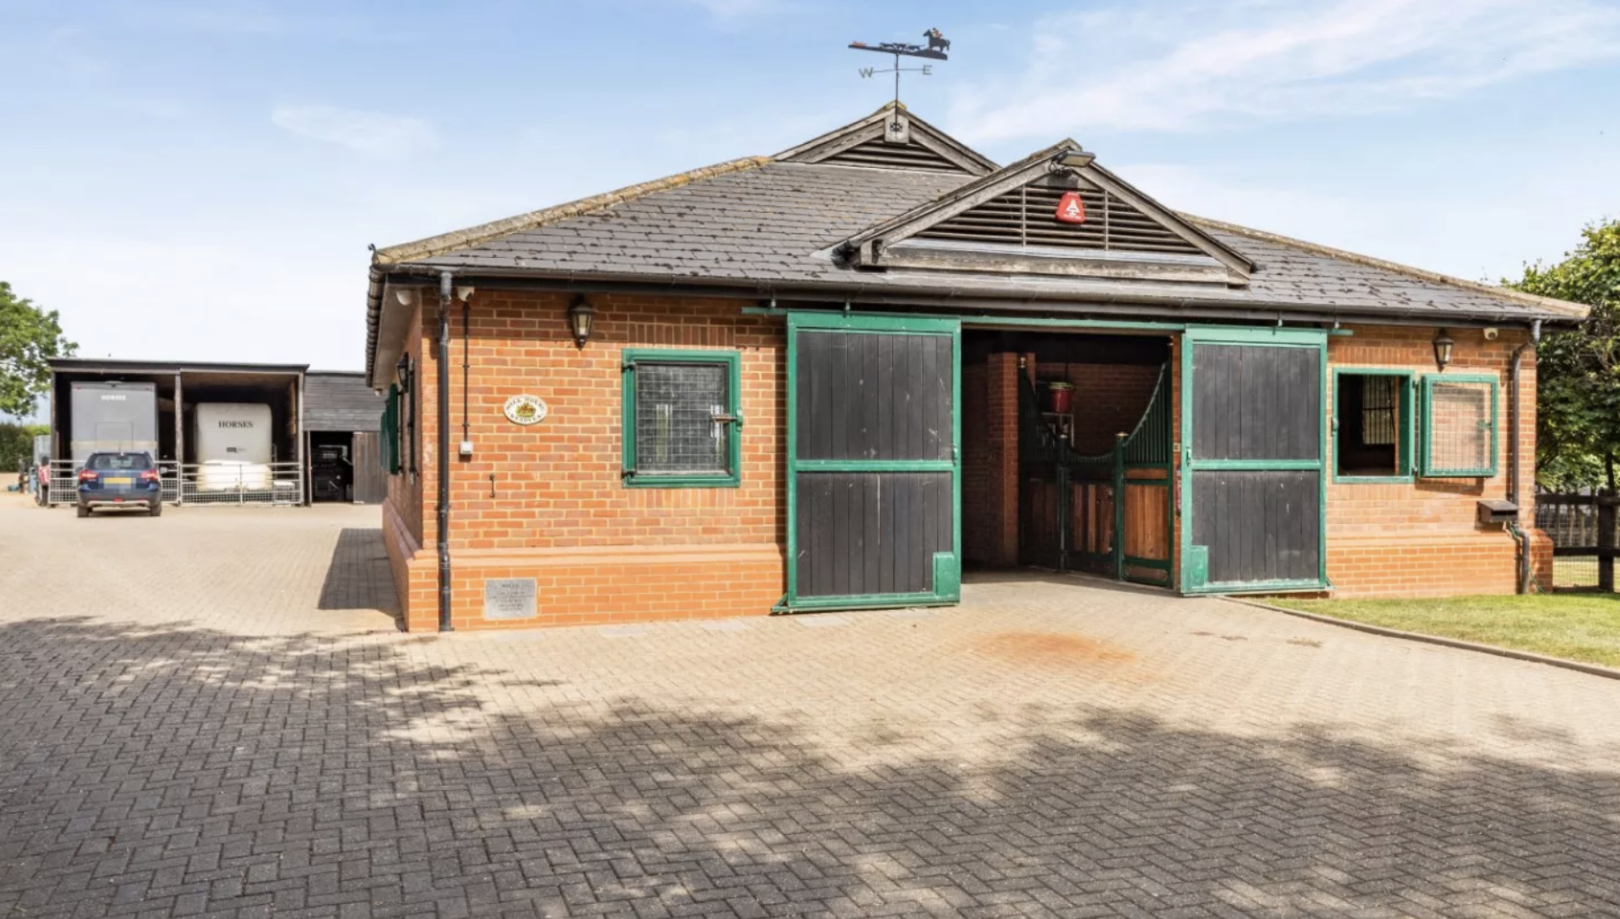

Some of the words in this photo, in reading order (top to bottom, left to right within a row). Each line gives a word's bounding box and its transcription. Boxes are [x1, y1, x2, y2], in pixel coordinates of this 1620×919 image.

[858, 66, 874, 79] W
[922, 65, 933, 75] E
[218, 420, 254, 428] HORSES
